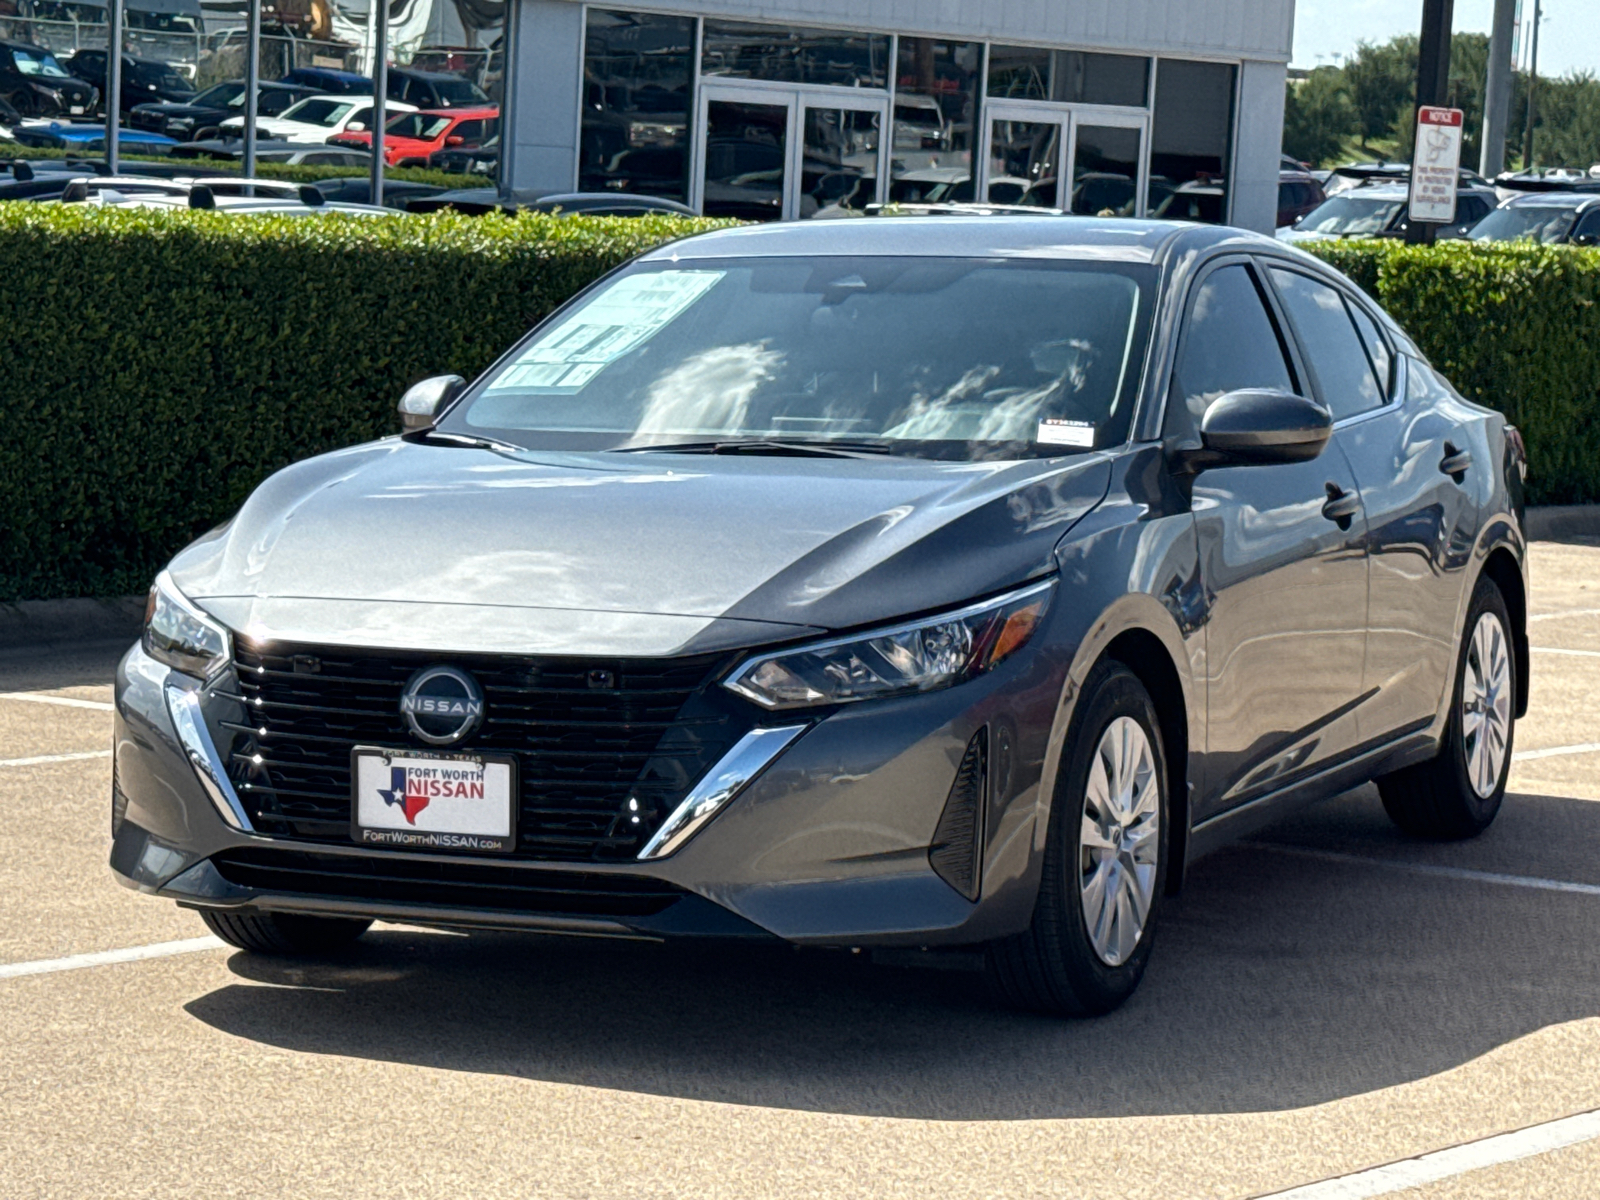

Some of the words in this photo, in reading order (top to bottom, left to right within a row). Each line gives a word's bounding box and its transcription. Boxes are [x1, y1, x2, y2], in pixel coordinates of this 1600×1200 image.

[403, 697, 481, 715] NISSAN
[453, 754, 482, 762] TEXAS
[408, 767, 438, 779] FORT
[441, 769, 484, 782] WORTH
[408, 779, 485, 799] NISSAN
